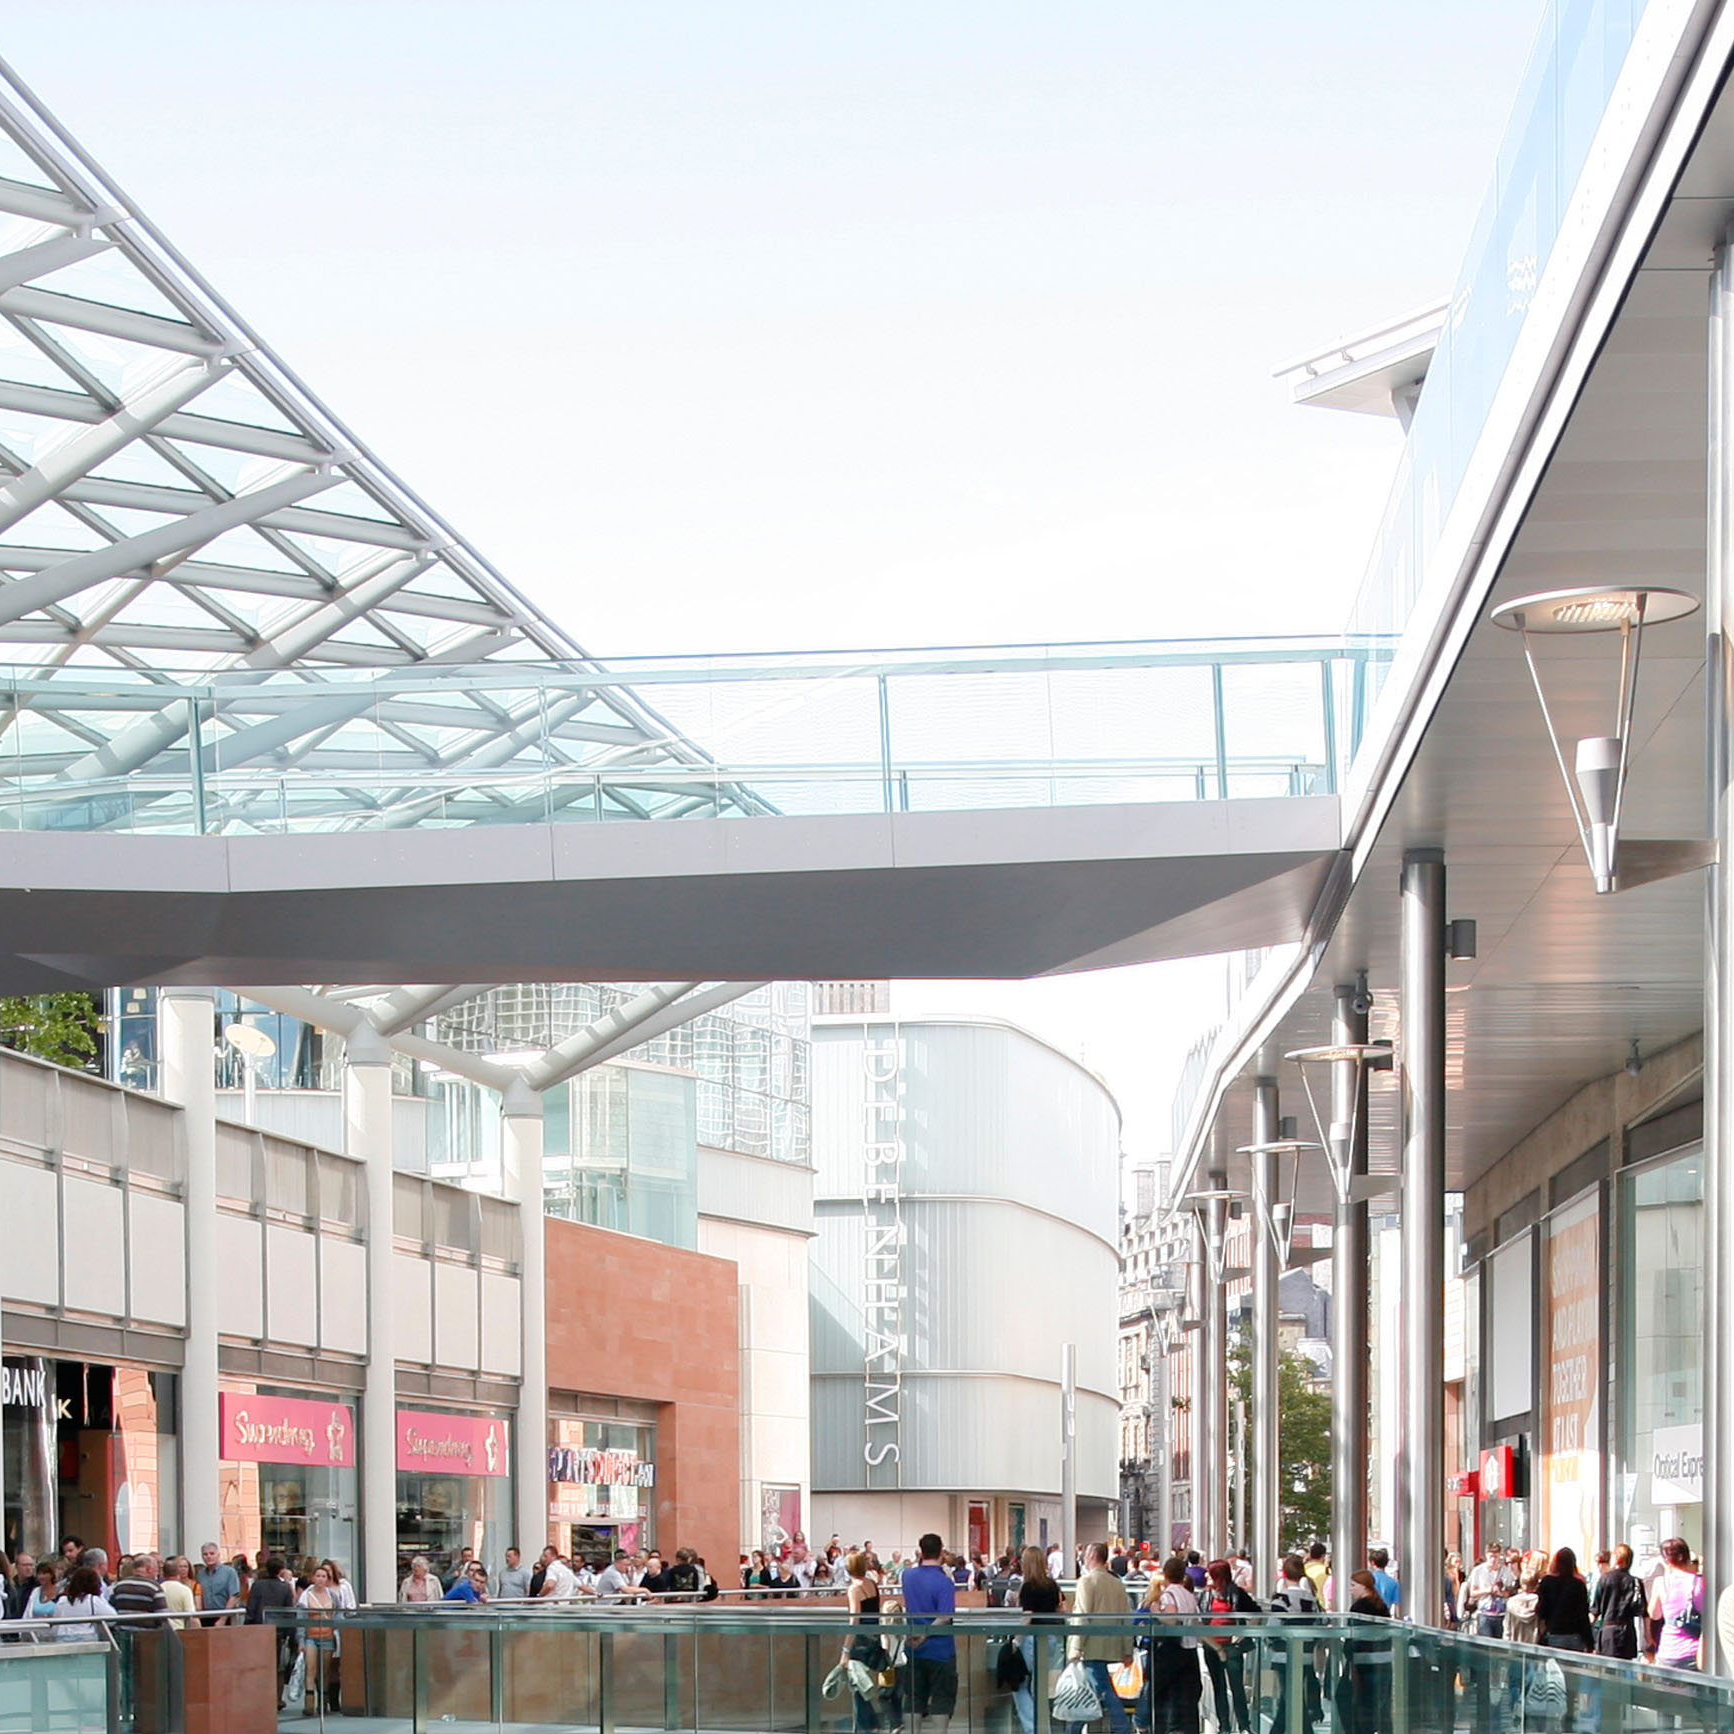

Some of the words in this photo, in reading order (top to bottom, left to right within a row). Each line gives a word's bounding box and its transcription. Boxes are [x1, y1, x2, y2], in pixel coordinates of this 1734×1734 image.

[864, 1048, 899, 1467] DEBENHAMS
[3, 1366, 45, 1407] BANK
[235, 1410, 316, 1458] Superdrug
[1682, 1452, 1703, 1484] Expre
